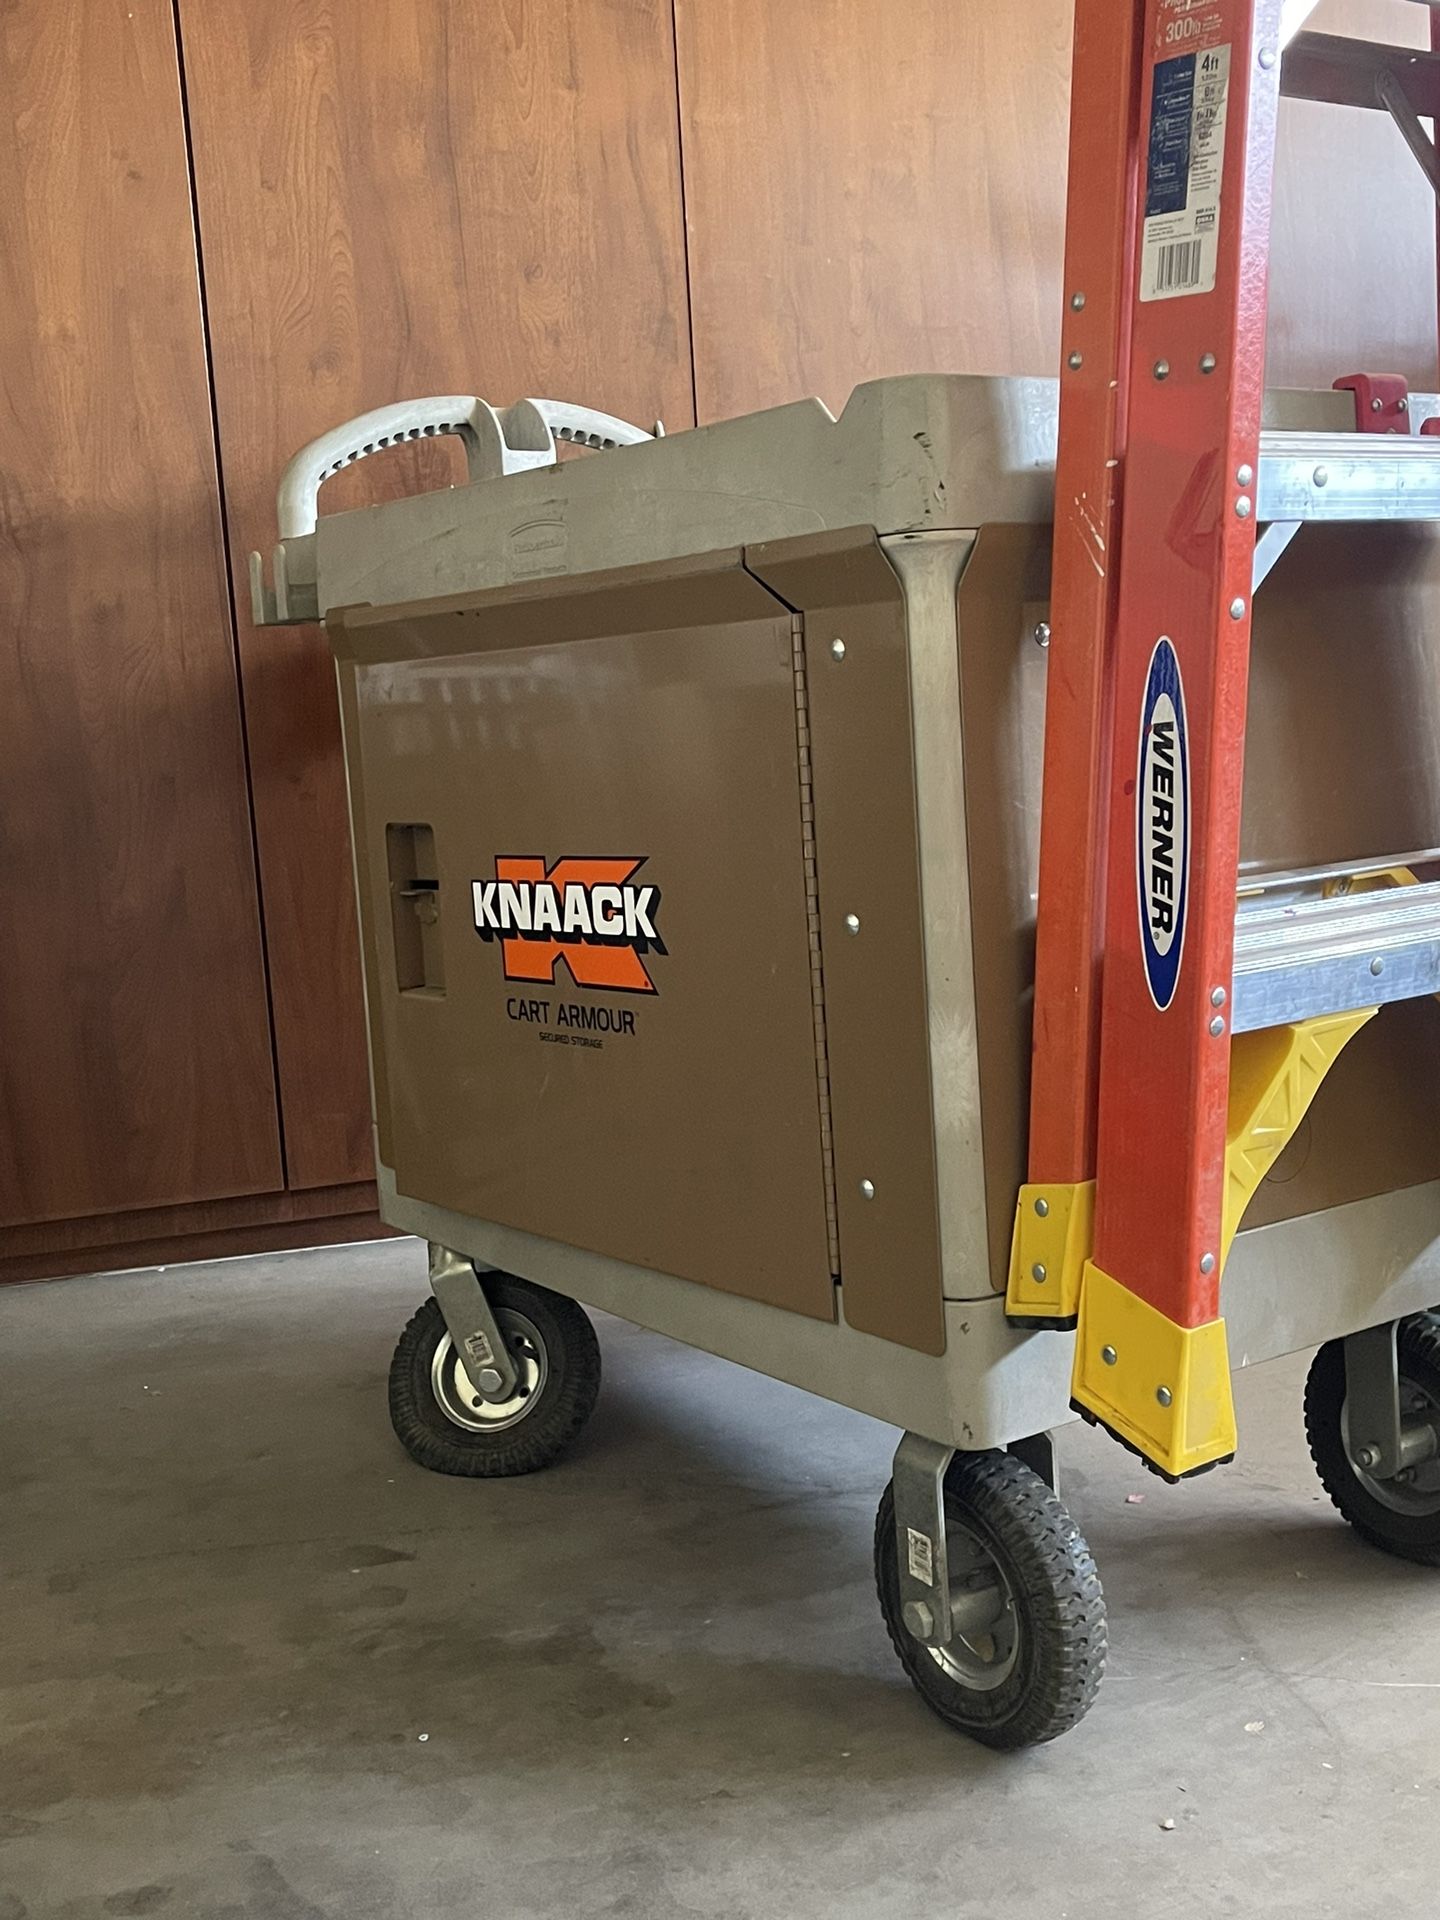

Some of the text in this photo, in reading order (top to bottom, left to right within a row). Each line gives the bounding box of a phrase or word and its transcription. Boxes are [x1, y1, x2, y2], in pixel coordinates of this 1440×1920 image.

[1152, 721, 1174, 934] WERNER
[471, 880, 661, 941] KNAACK
[506, 999, 636, 1036] CART ARMOUR
[539, 1031, 603, 1049] SECURED STORAGE
